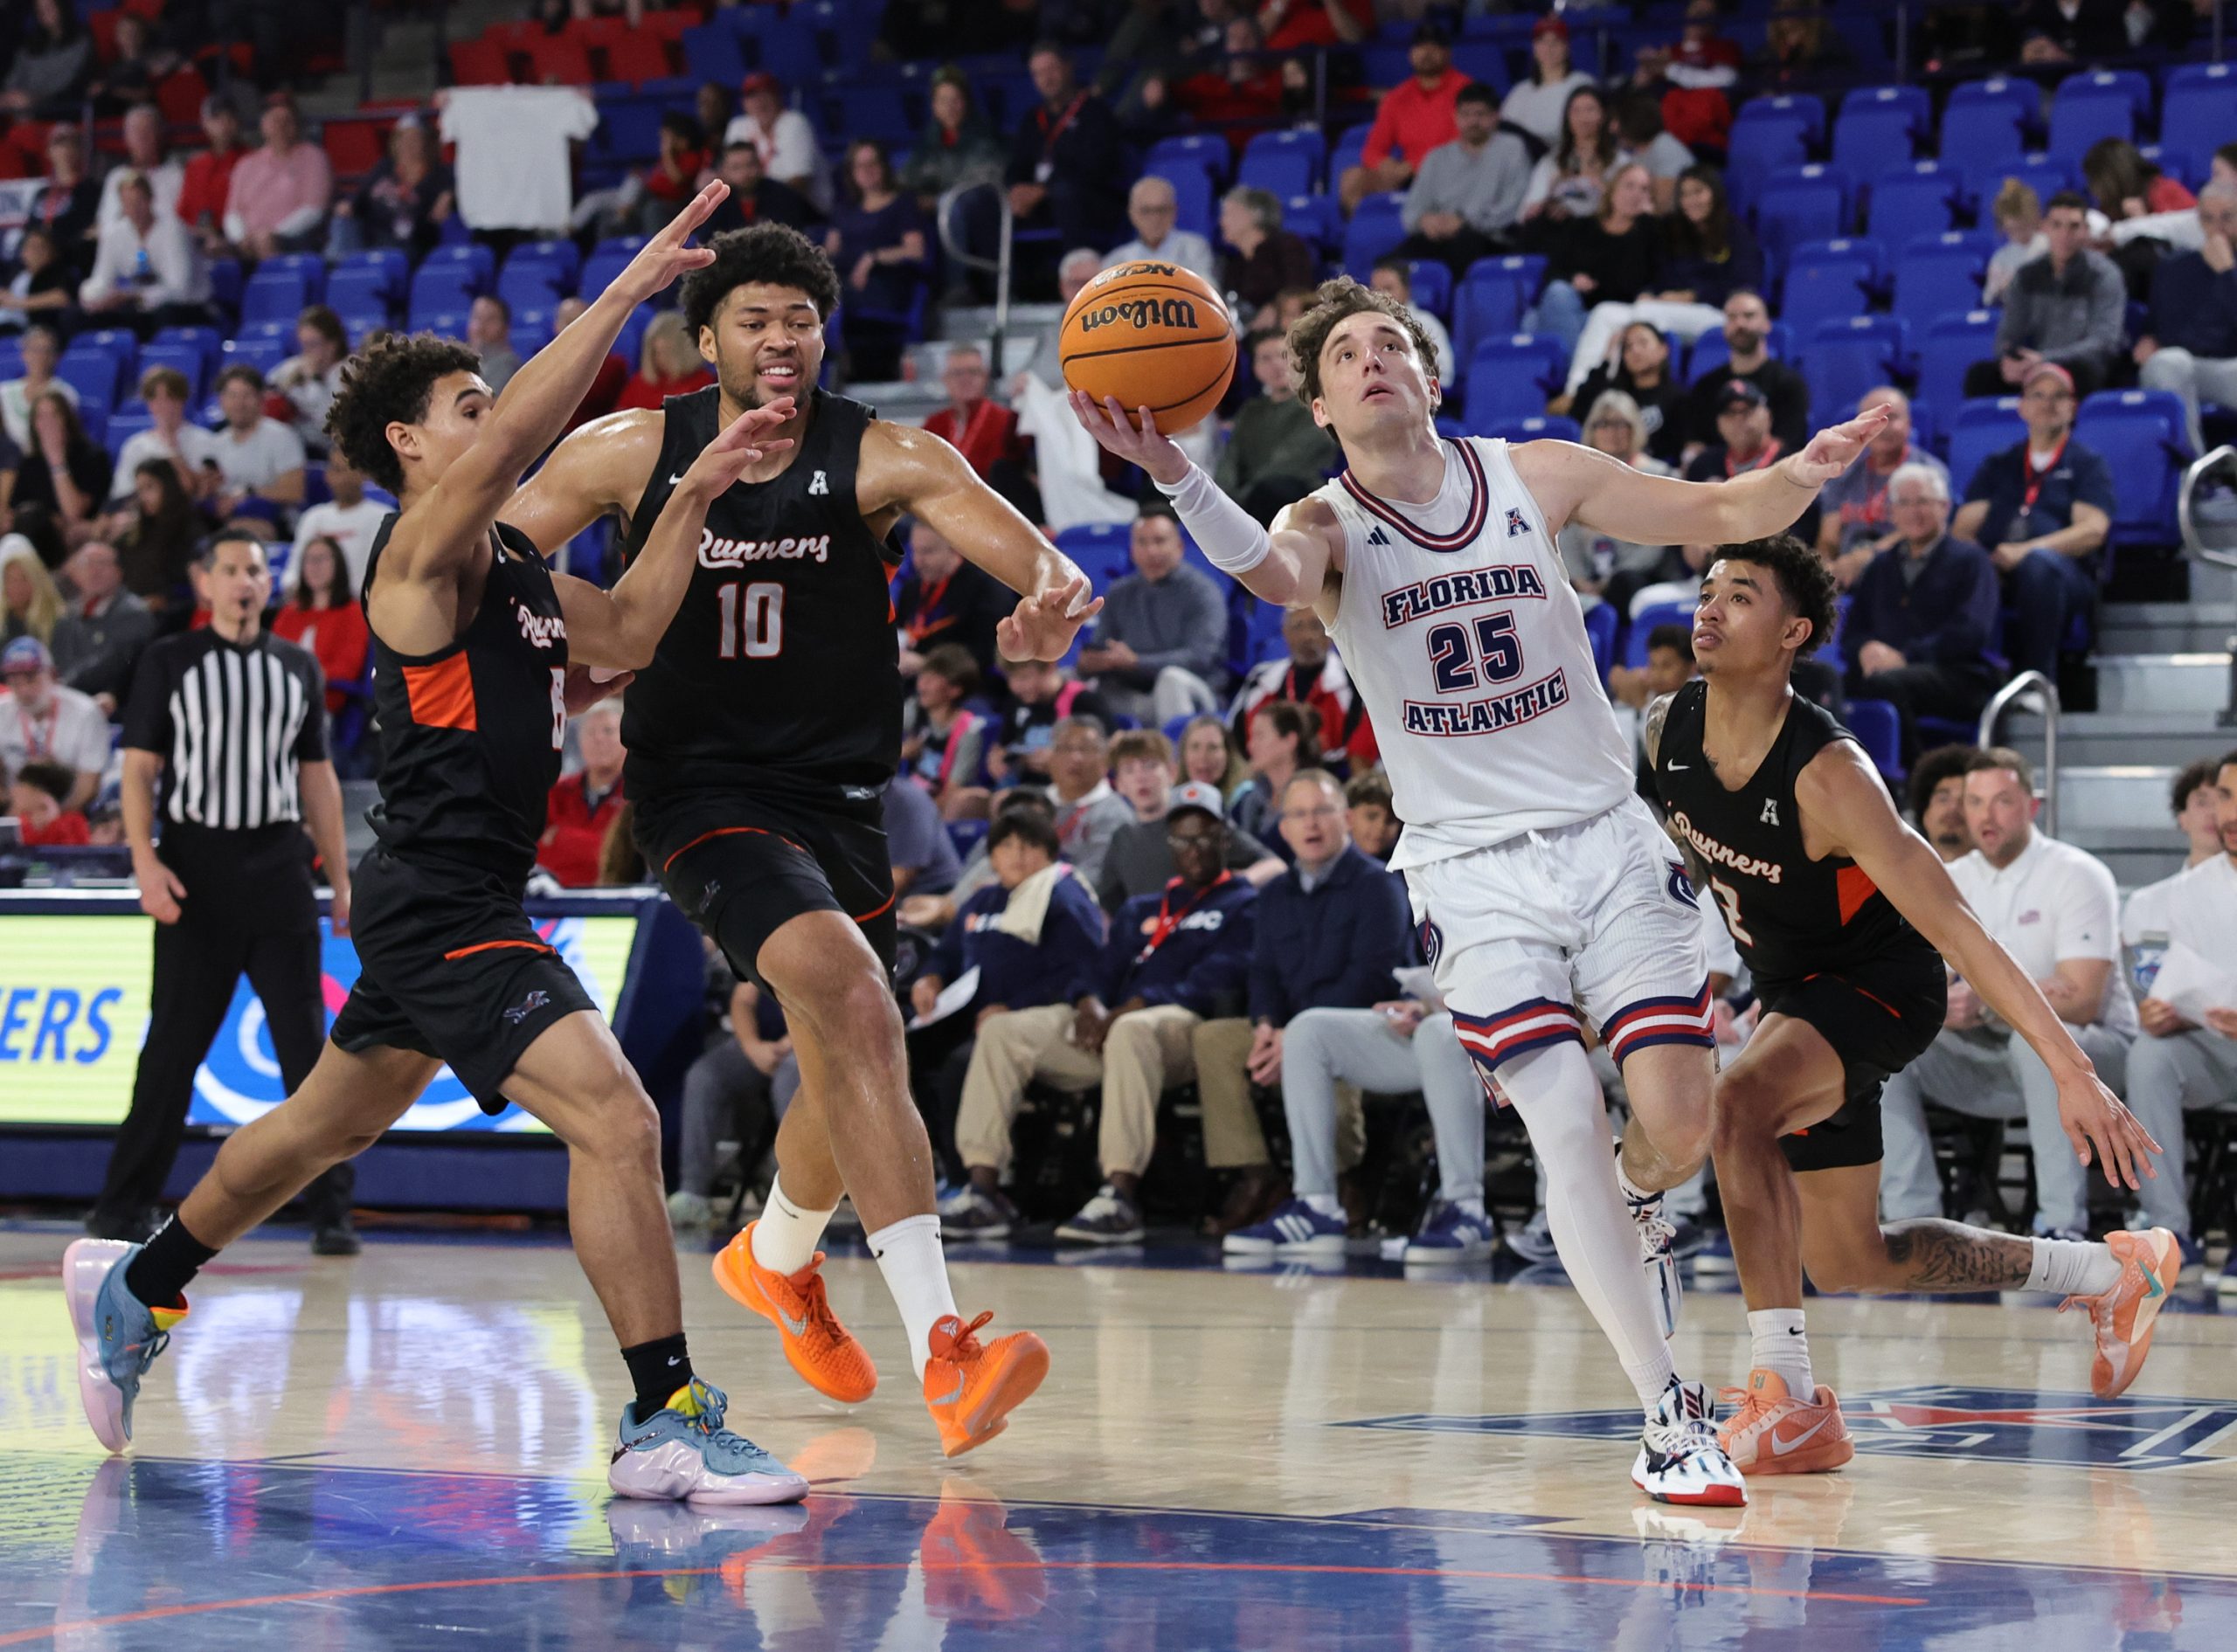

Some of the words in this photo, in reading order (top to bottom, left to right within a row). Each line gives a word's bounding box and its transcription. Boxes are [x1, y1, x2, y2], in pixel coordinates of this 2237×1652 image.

[1081, 298, 1198, 332] Wilson
[698, 527, 830, 569] Runners
[717, 581, 784, 659] 10
[1382, 564, 1547, 630] FLORIDA
[1426, 610, 1523, 694] 25
[1402, 667, 1569, 736] ATLANTIC
[1709, 874, 1755, 949] 2
[0, 986, 124, 1065] ERS
